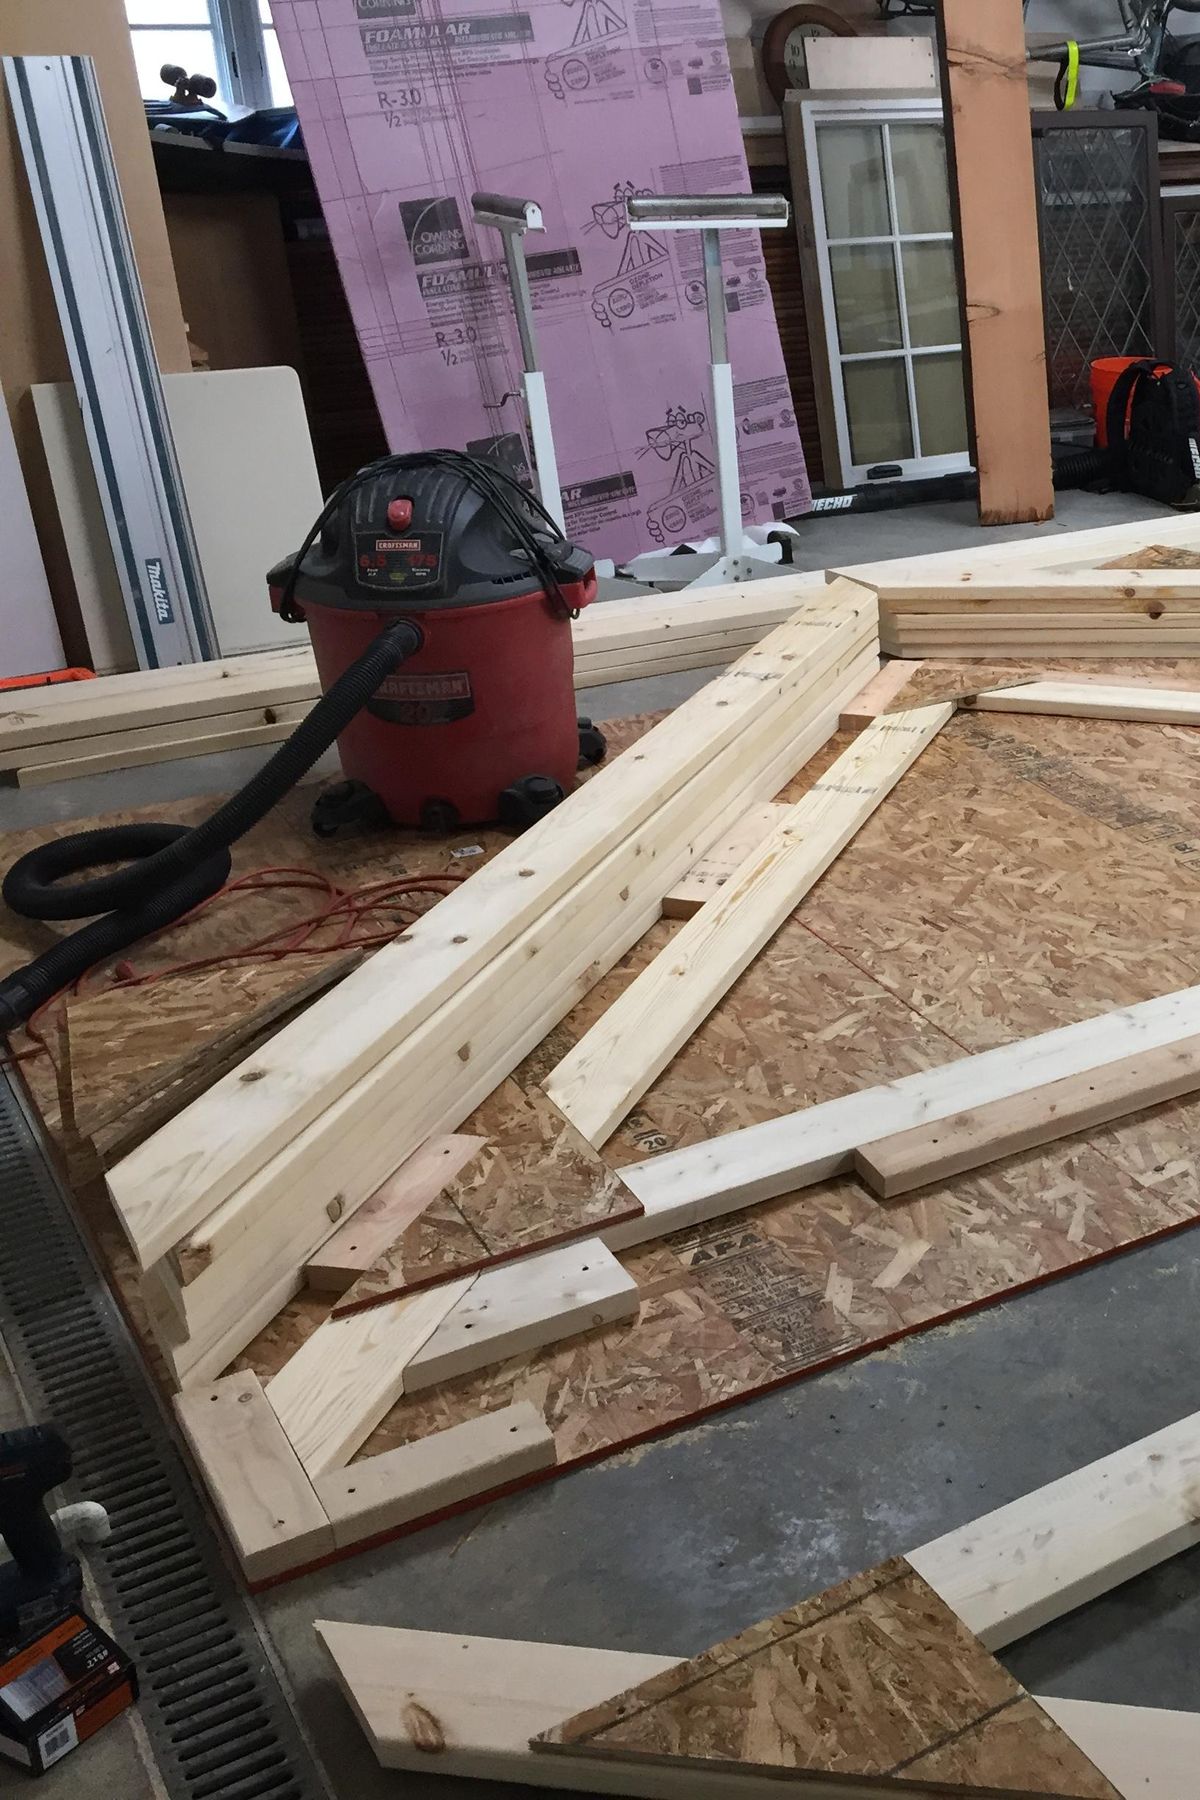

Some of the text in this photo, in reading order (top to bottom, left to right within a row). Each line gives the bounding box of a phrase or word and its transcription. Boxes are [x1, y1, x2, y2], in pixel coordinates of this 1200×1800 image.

[420, 228, 464, 244] OWENS
[415, 241, 466, 256] CORNING
[421, 263, 510, 288] FOAMULA
[818, 495, 855, 512] ECHO
[381, 680, 463, 696] RAFTSMAN
[643, 1136, 668, 1150] 20
